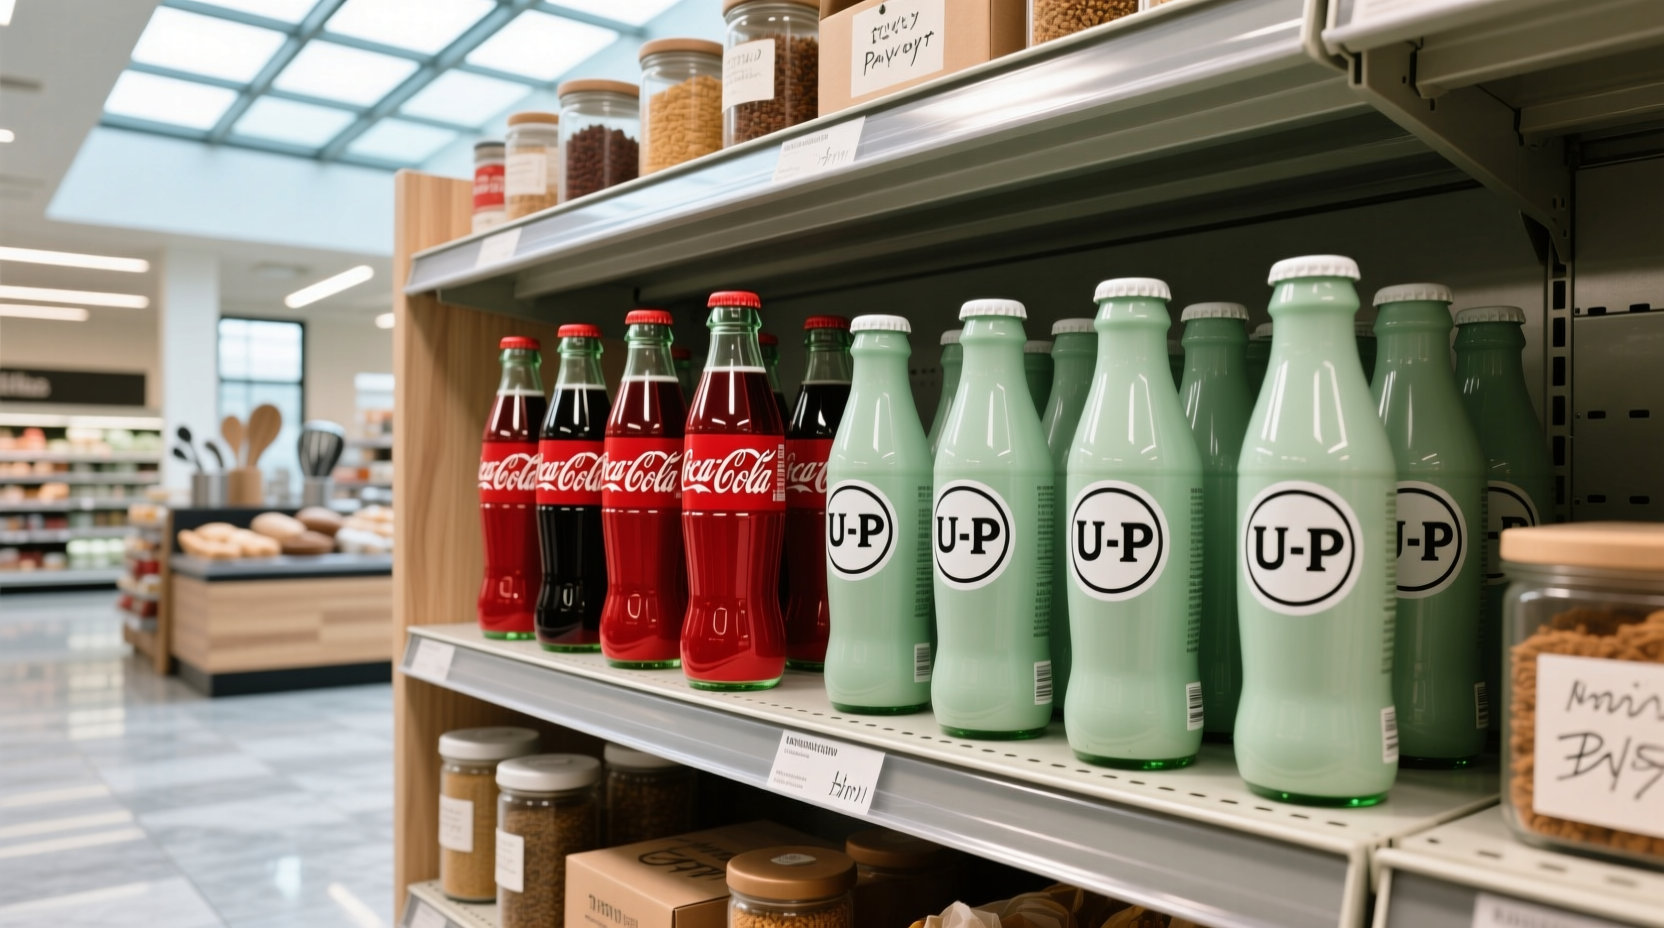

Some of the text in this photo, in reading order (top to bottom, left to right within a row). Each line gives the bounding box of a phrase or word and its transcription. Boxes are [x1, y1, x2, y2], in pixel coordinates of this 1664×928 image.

[828, 513, 885, 548] U-P
[936, 516, 1001, 555] U-P
[1076, 520, 1154, 563] U-P
[1253, 526, 1345, 572] U-P
